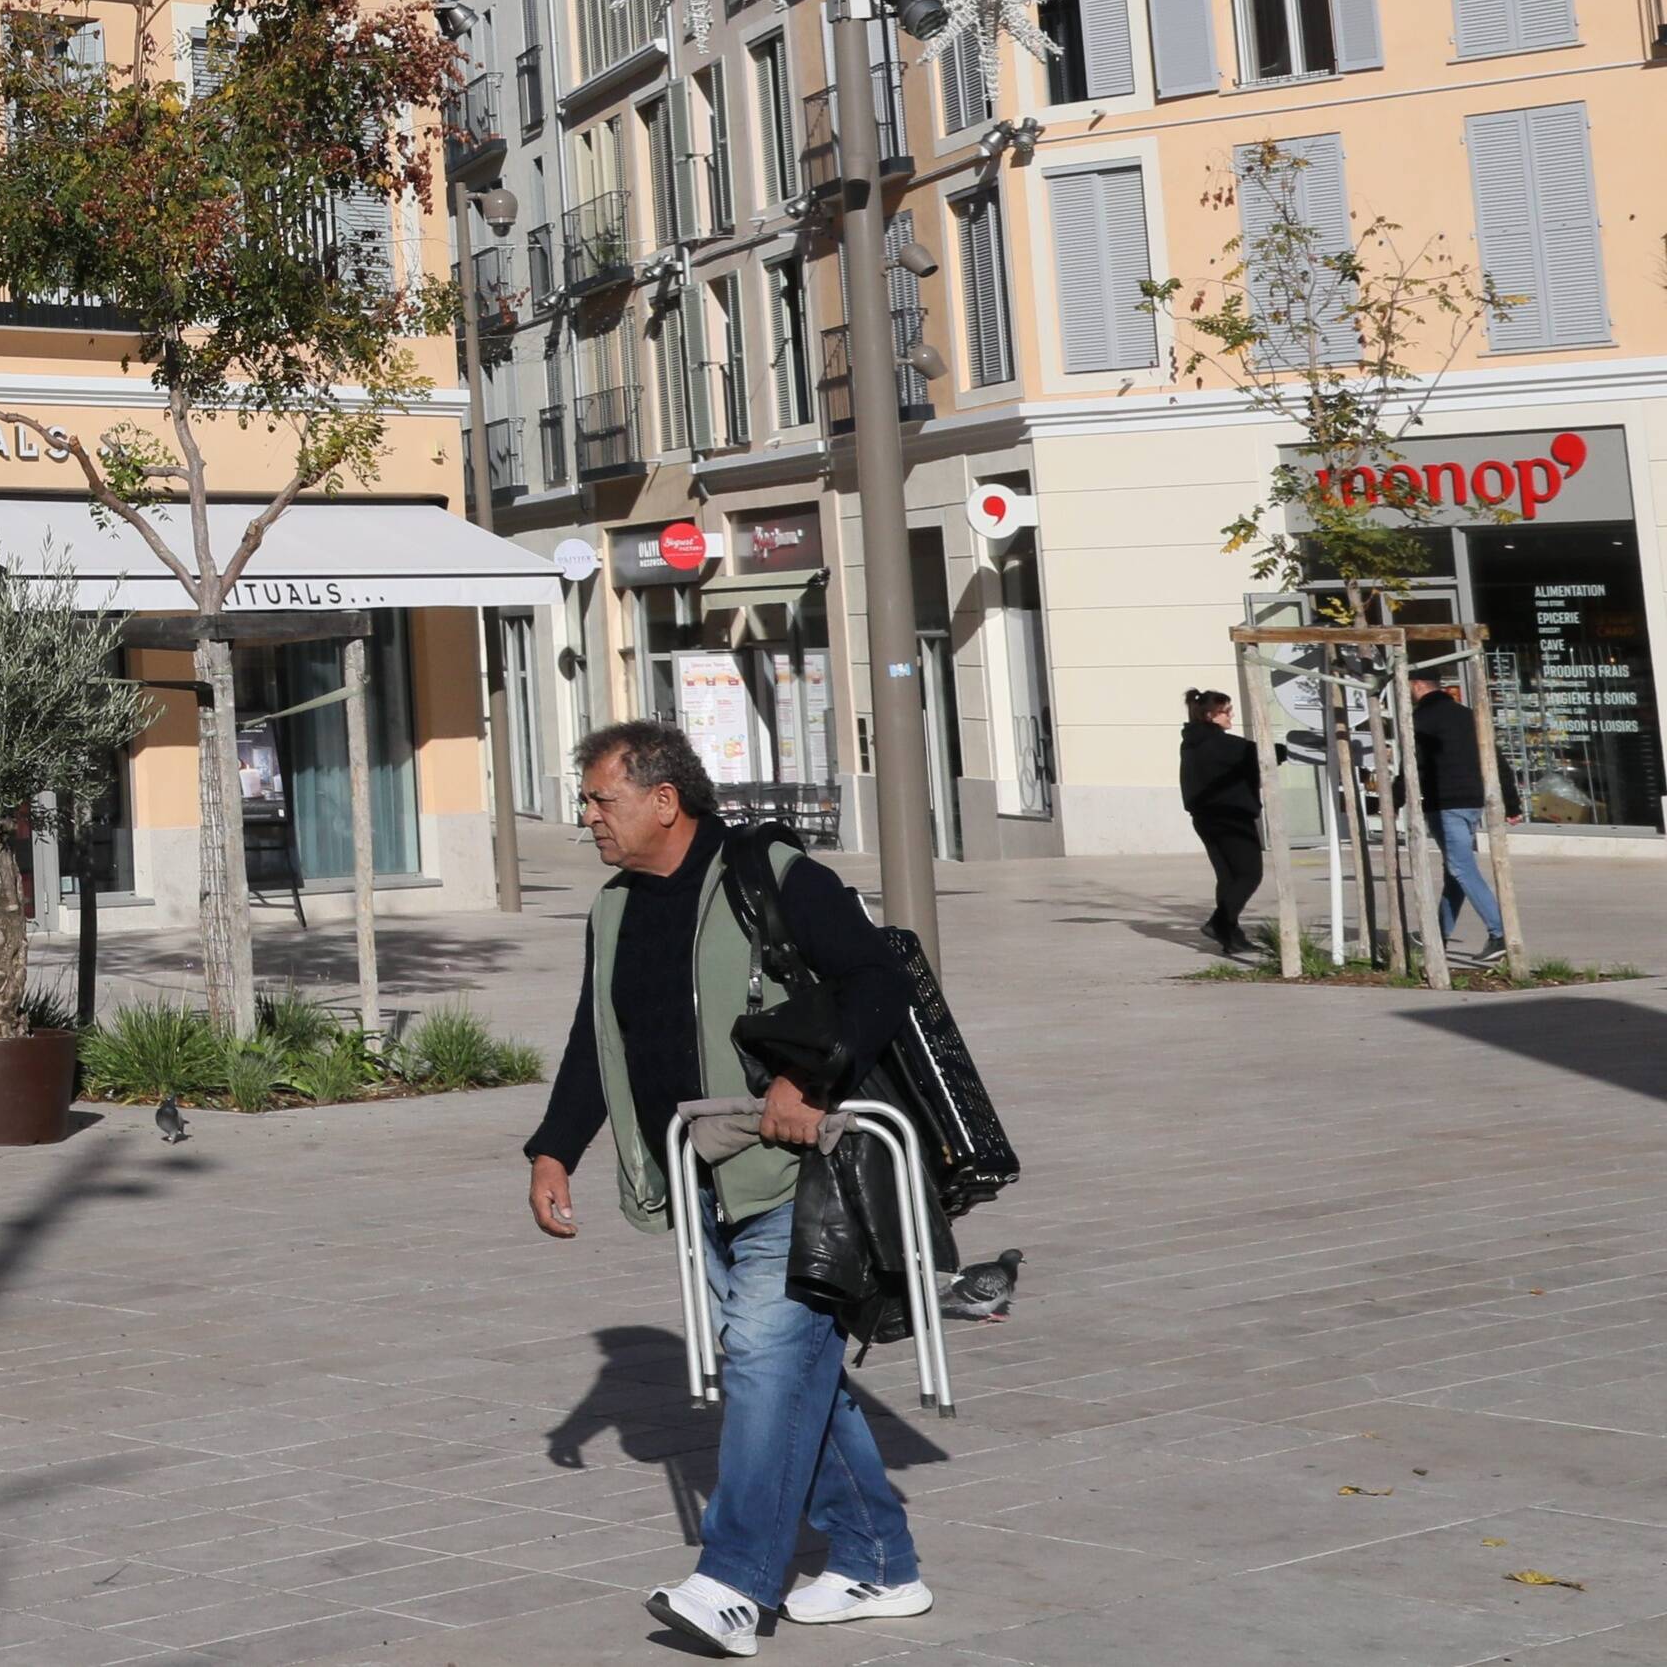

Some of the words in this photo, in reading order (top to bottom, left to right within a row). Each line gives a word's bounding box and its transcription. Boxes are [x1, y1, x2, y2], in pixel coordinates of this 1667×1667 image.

[222, 583, 385, 606] ITUALS...
[1534, 584, 1606, 597] ALIMENTATION
[1537, 611, 1581, 624] EPICERIE
[1540, 639, 1565, 652] CAVE
[1543, 665, 1595, 678] PRODUITS
[1598, 664, 1630, 677] FRAIS
[1604, 692, 1637, 705] SOINS
[1600, 720, 1639, 732] LOISIRS
